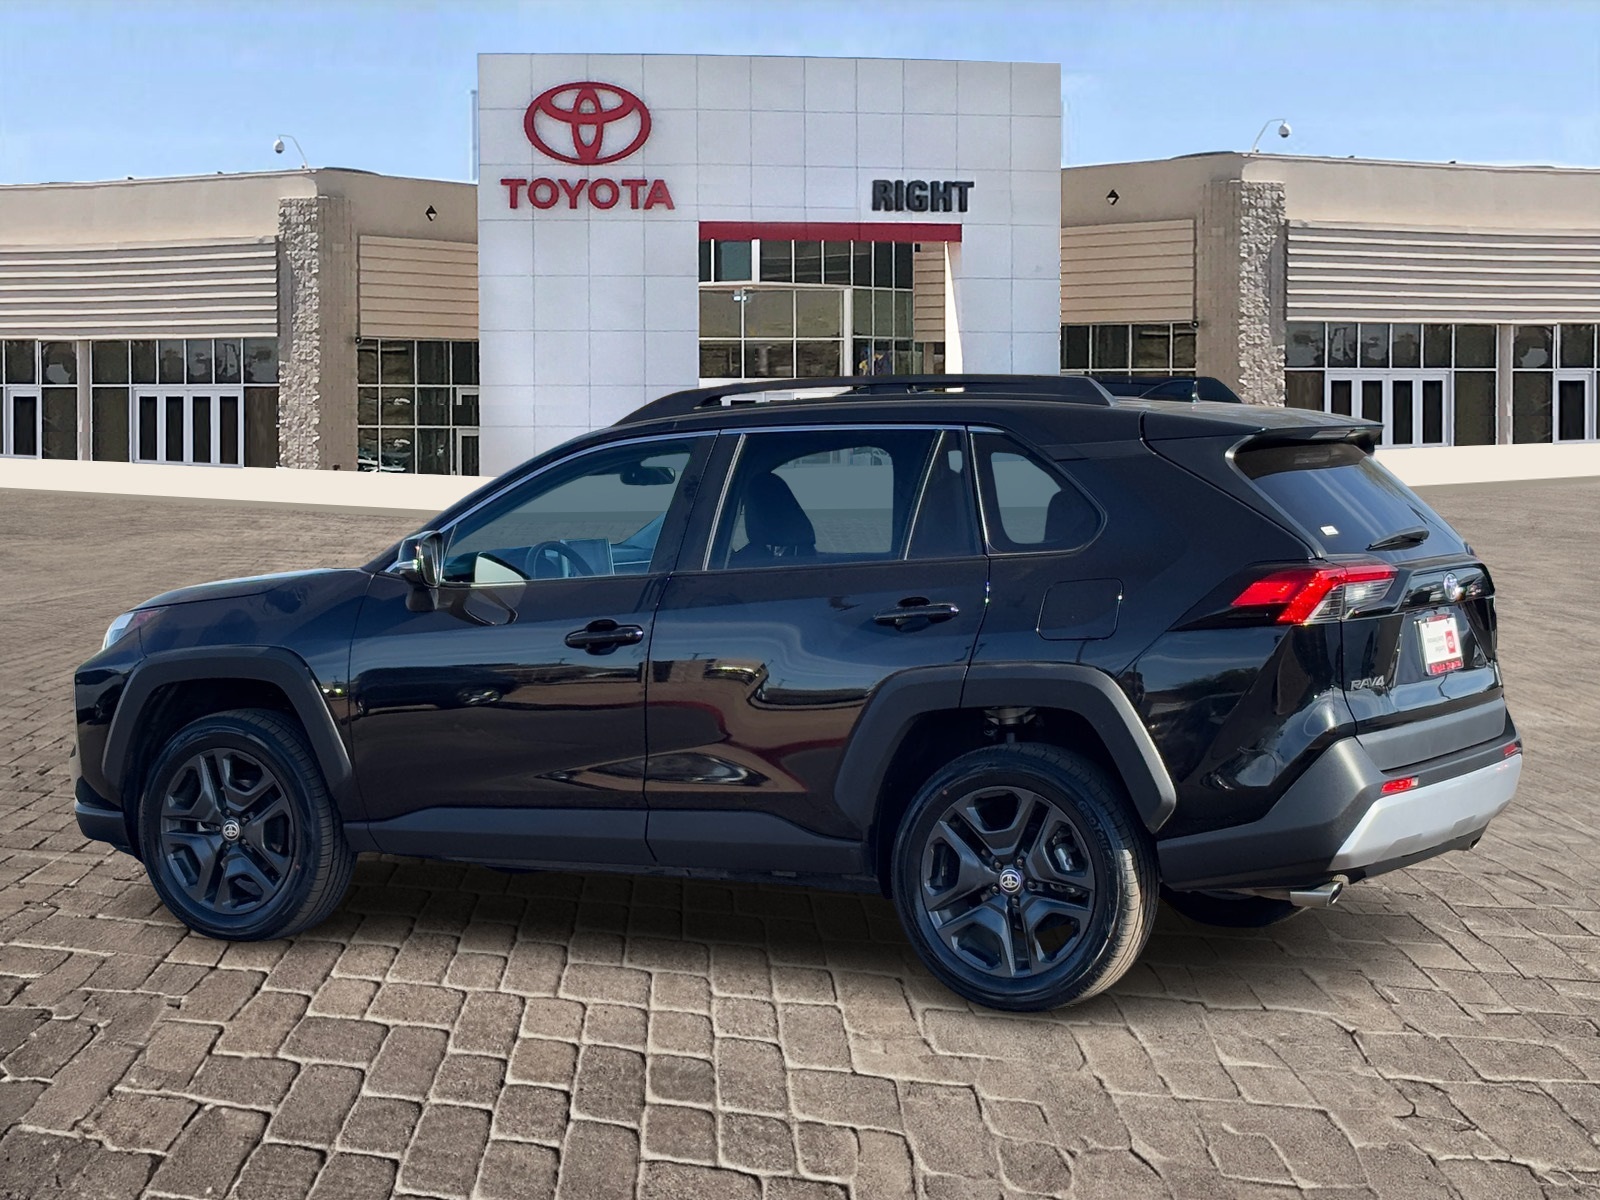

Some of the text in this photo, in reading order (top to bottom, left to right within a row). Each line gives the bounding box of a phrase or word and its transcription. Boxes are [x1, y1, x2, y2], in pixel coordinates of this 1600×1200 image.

[500, 178, 675, 210] TOYOTA
[872, 179, 975, 212] RIGHT
[1350, 675, 1385, 690] RAV4
